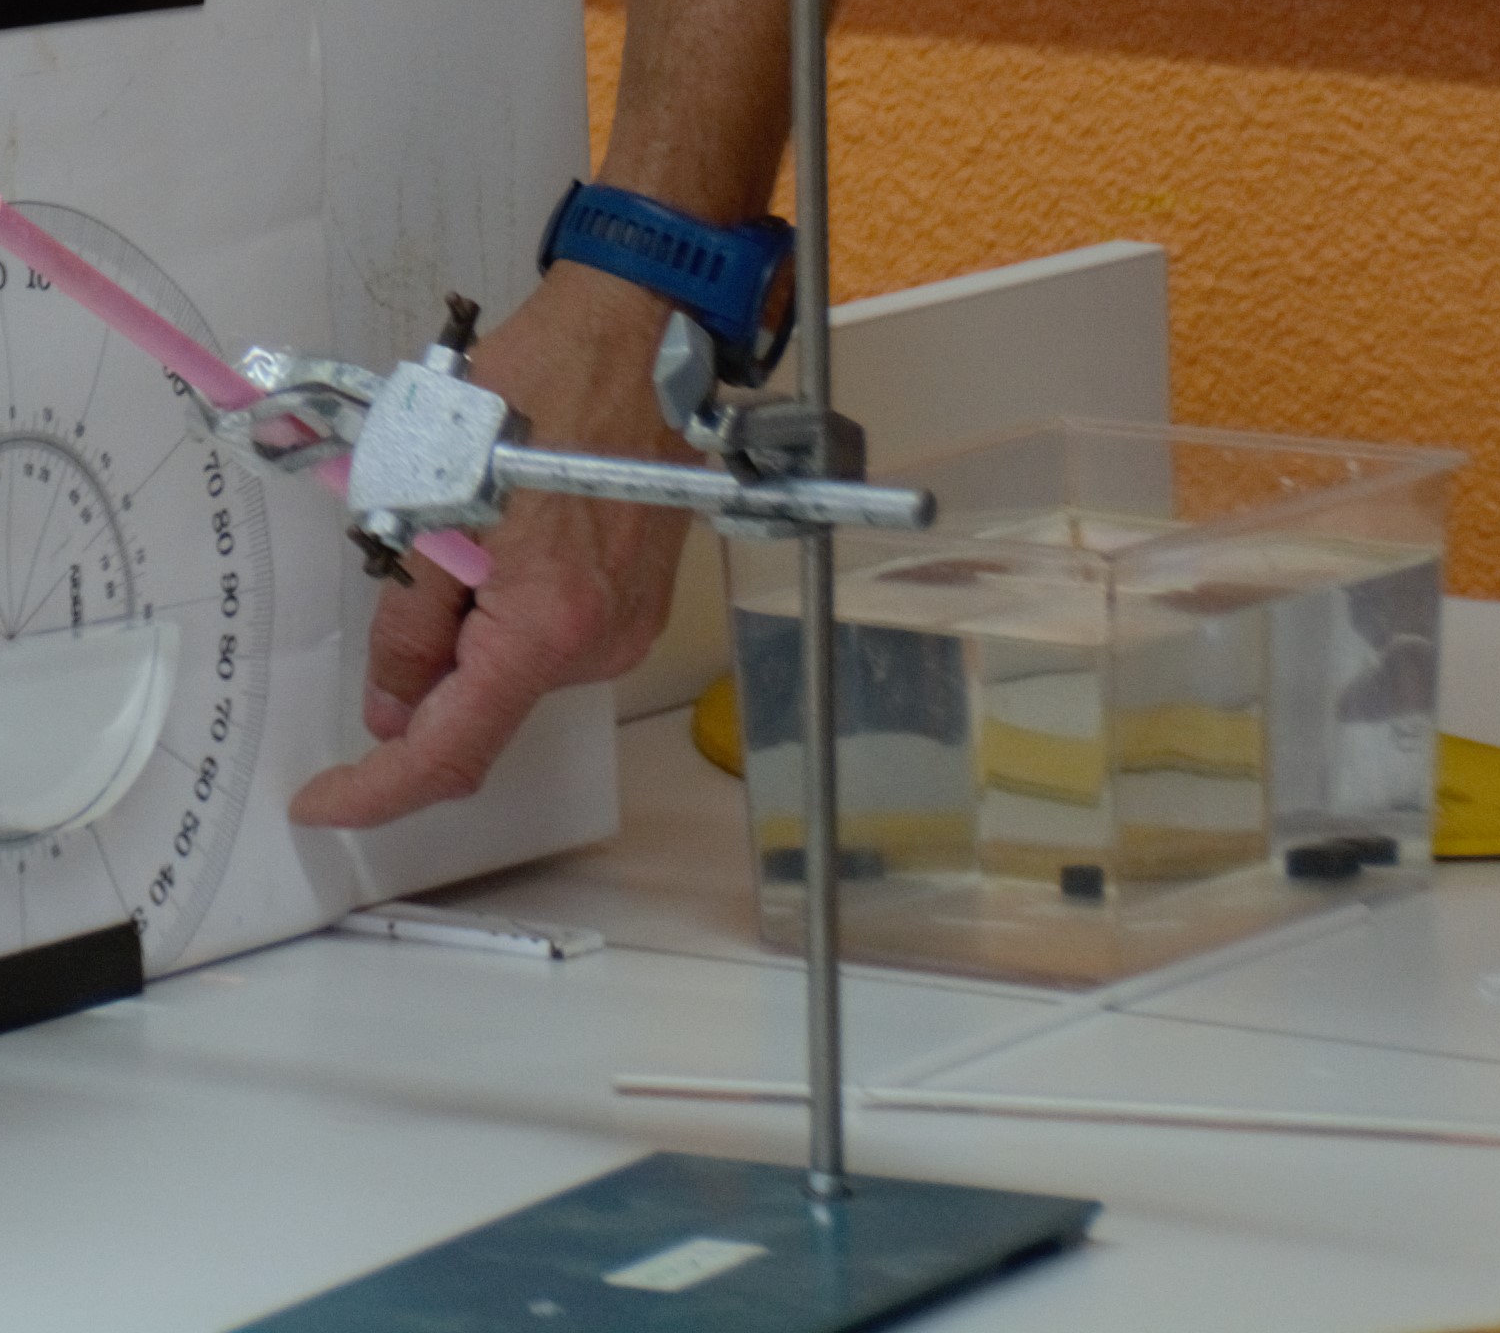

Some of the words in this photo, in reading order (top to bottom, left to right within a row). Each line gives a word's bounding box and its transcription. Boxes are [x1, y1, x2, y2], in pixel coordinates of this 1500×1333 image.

[203, 450, 225, 498] 70
[212, 508, 235, 556] 80
[219, 571, 240, 619] 90
[216, 632, 238, 680] 80
[210, 697, 233, 743] 70
[194, 755, 219, 802] 60
[173, 809, 200, 858] 50
[149, 863, 176, 907] 40
